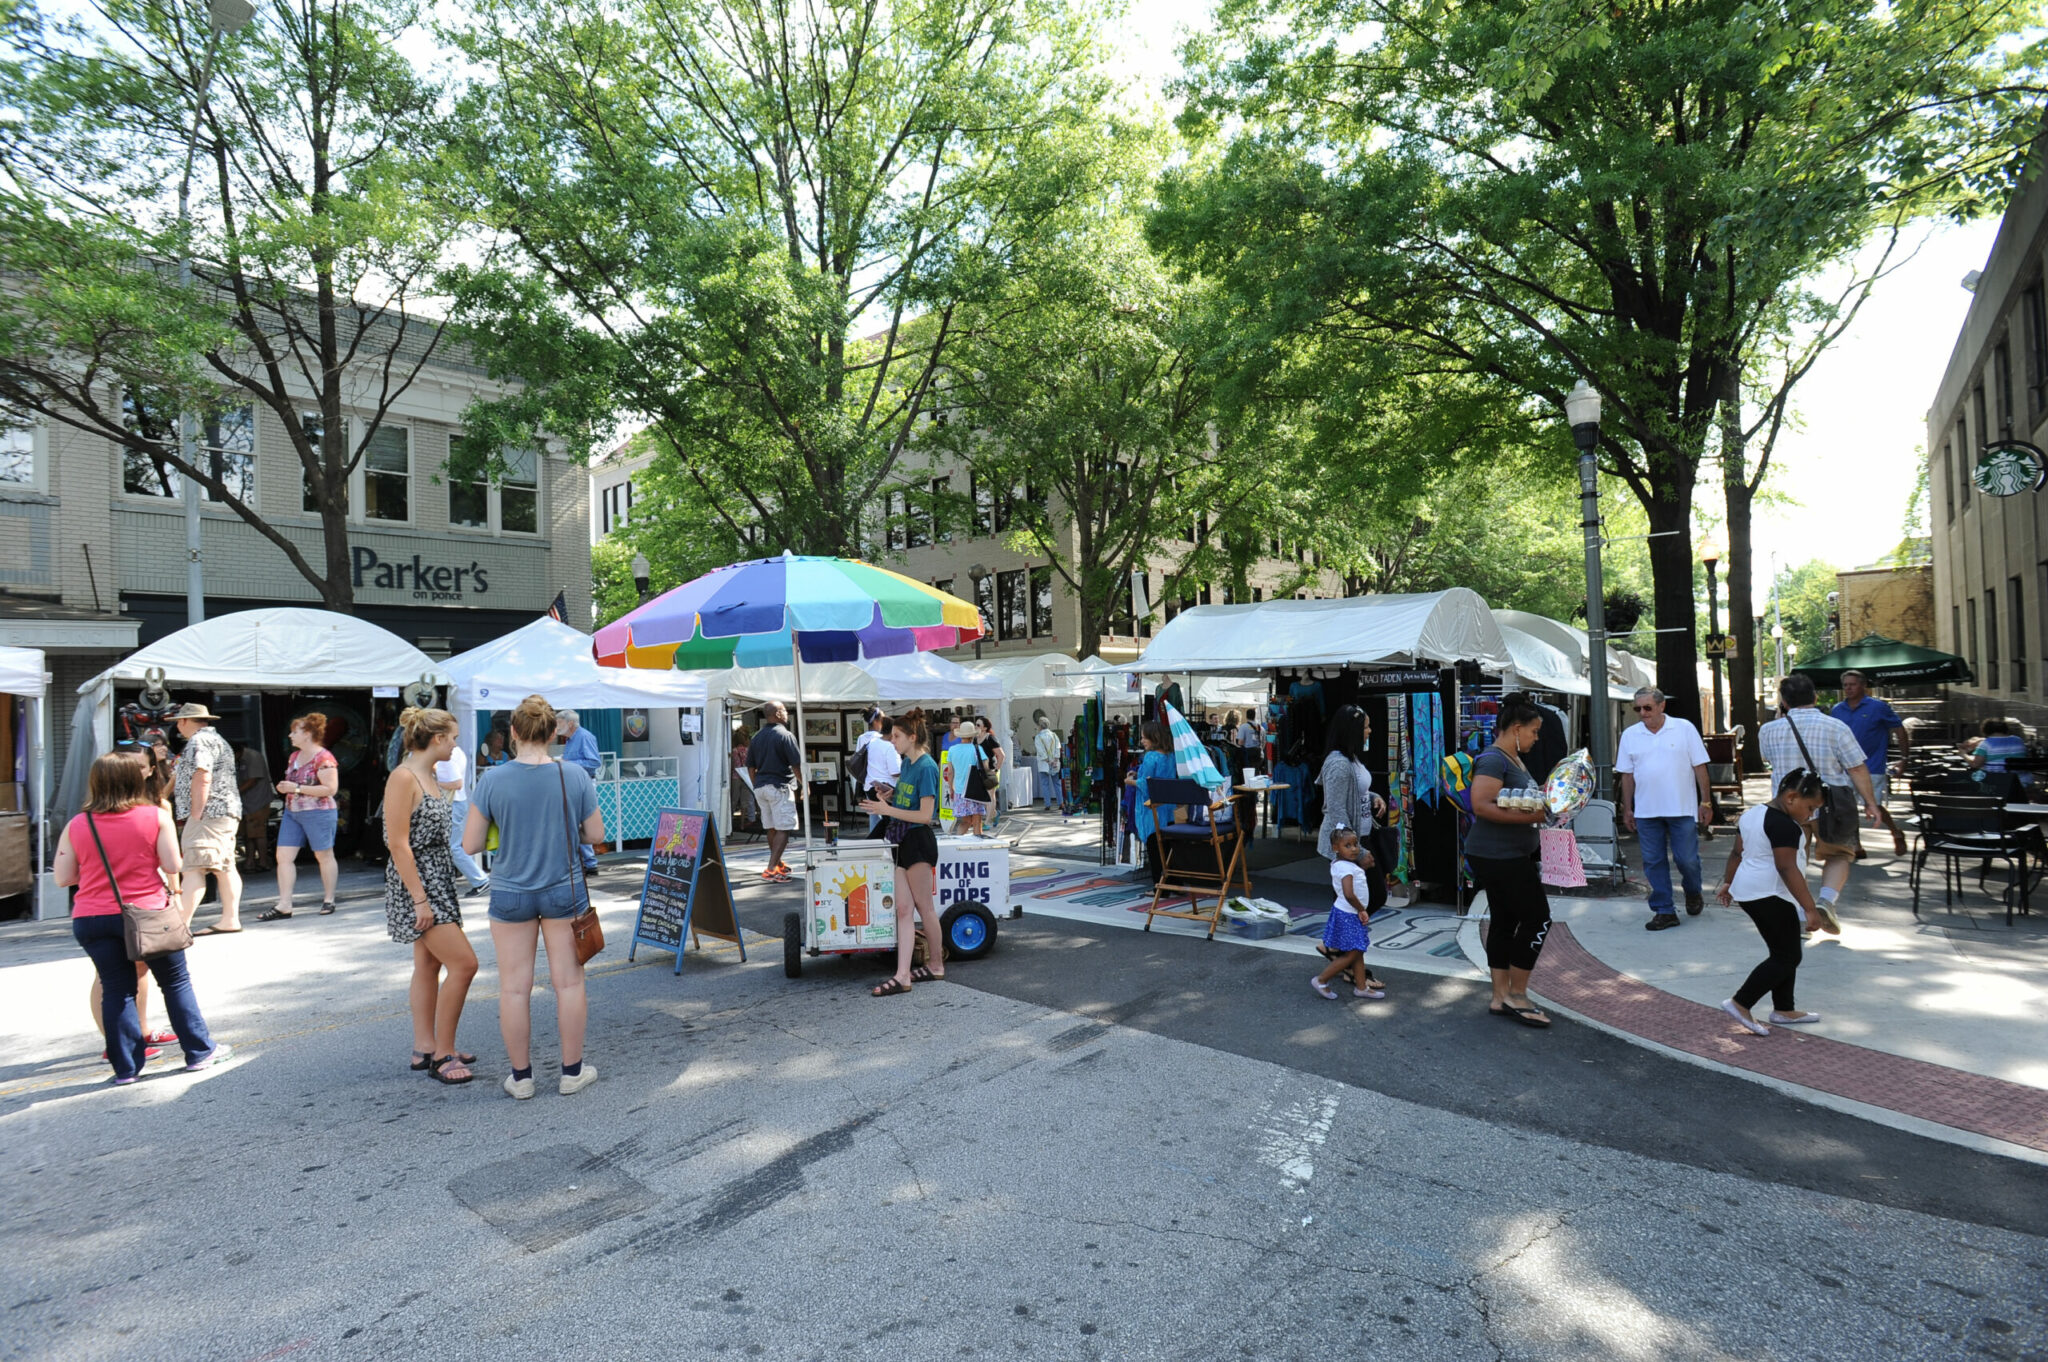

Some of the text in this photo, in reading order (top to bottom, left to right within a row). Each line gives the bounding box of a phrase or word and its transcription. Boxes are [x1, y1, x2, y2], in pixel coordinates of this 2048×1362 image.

[352, 546, 488, 593] Parker's
[413, 591, 463, 601] on ponce
[1360, 674, 1378, 684] TRACI
[666, 866, 677, 876] $3
[940, 861, 990, 880] KING
[958, 878, 971, 888] OF
[940, 887, 990, 905] POPS
